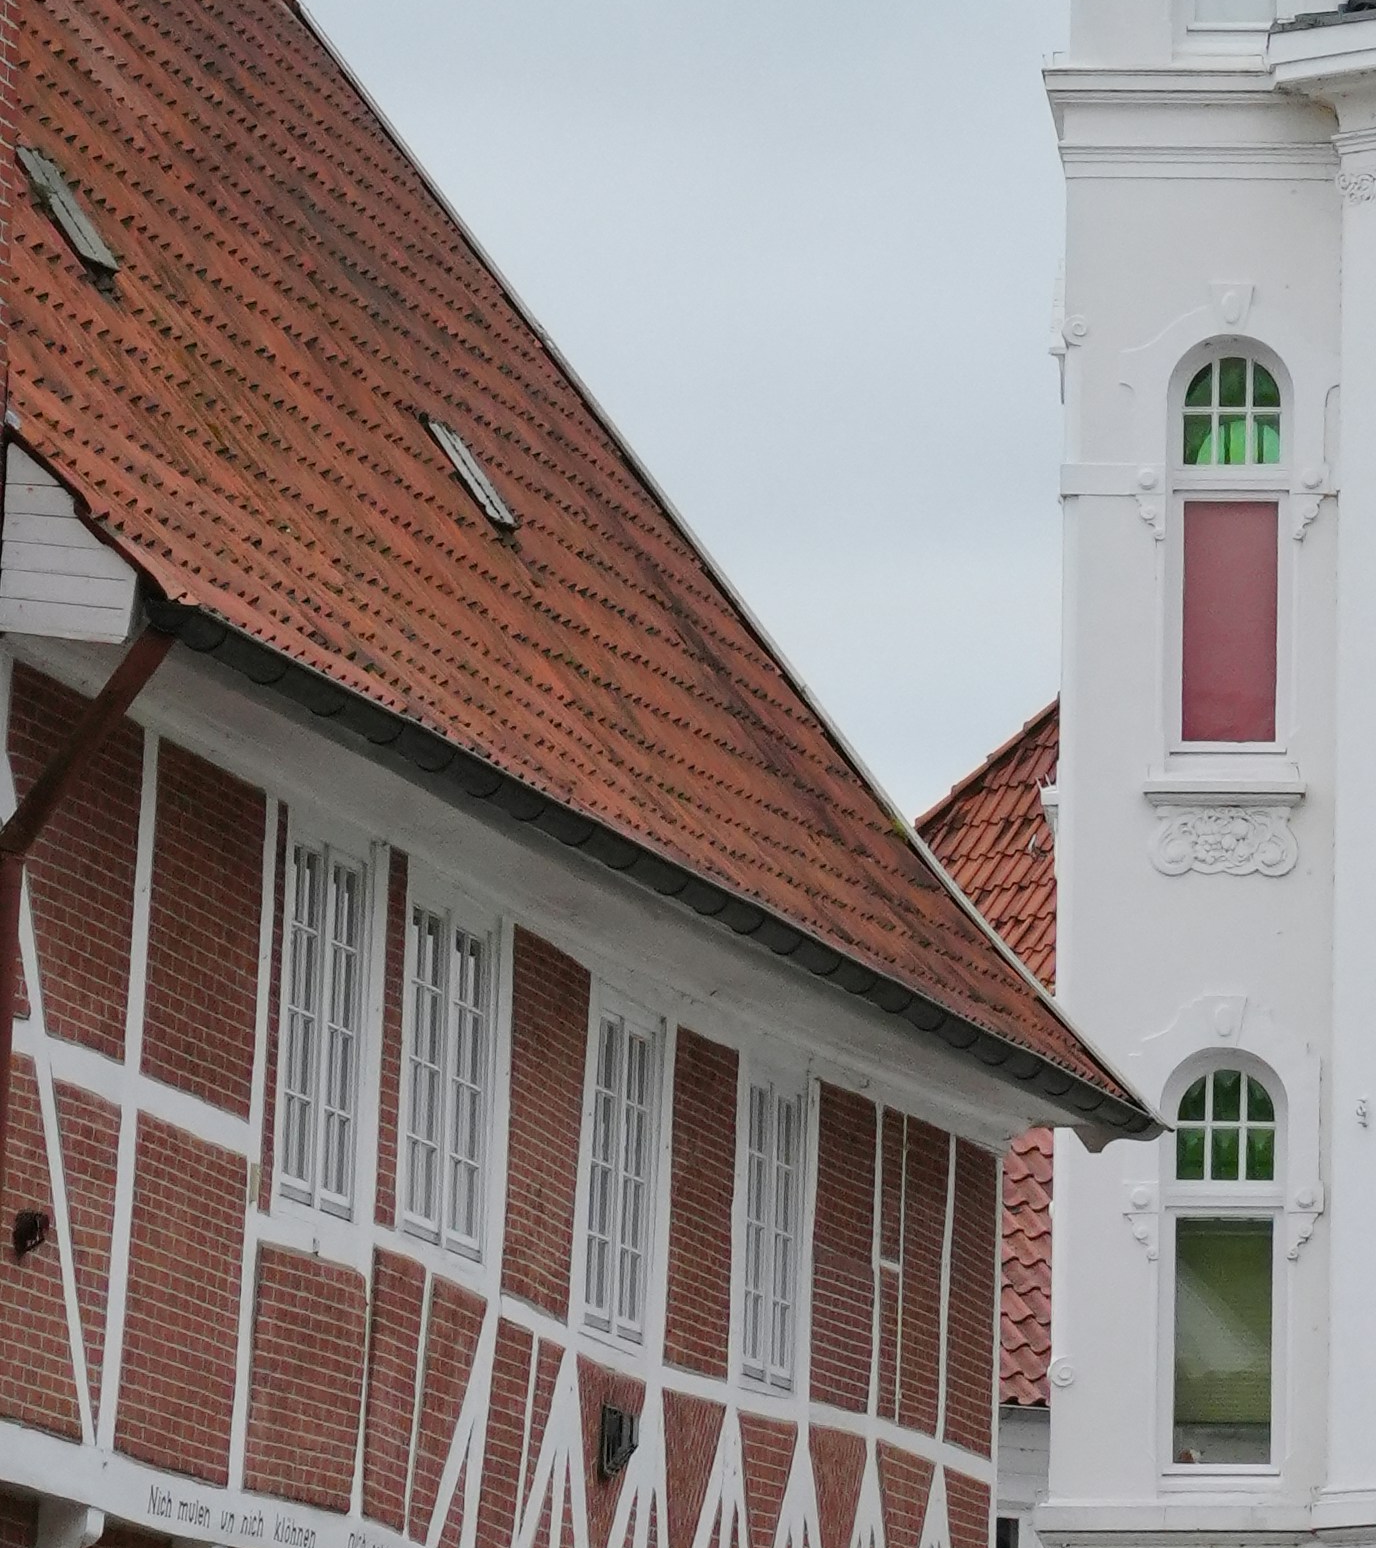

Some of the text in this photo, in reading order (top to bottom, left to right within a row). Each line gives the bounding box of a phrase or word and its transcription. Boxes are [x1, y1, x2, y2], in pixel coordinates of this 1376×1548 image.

[147, 1484, 172, 1518] Nich
[177, 1500, 210, 1528] mulen
[220, 1510, 235, 1533] un
[240, 1509, 264, 1537] nich
